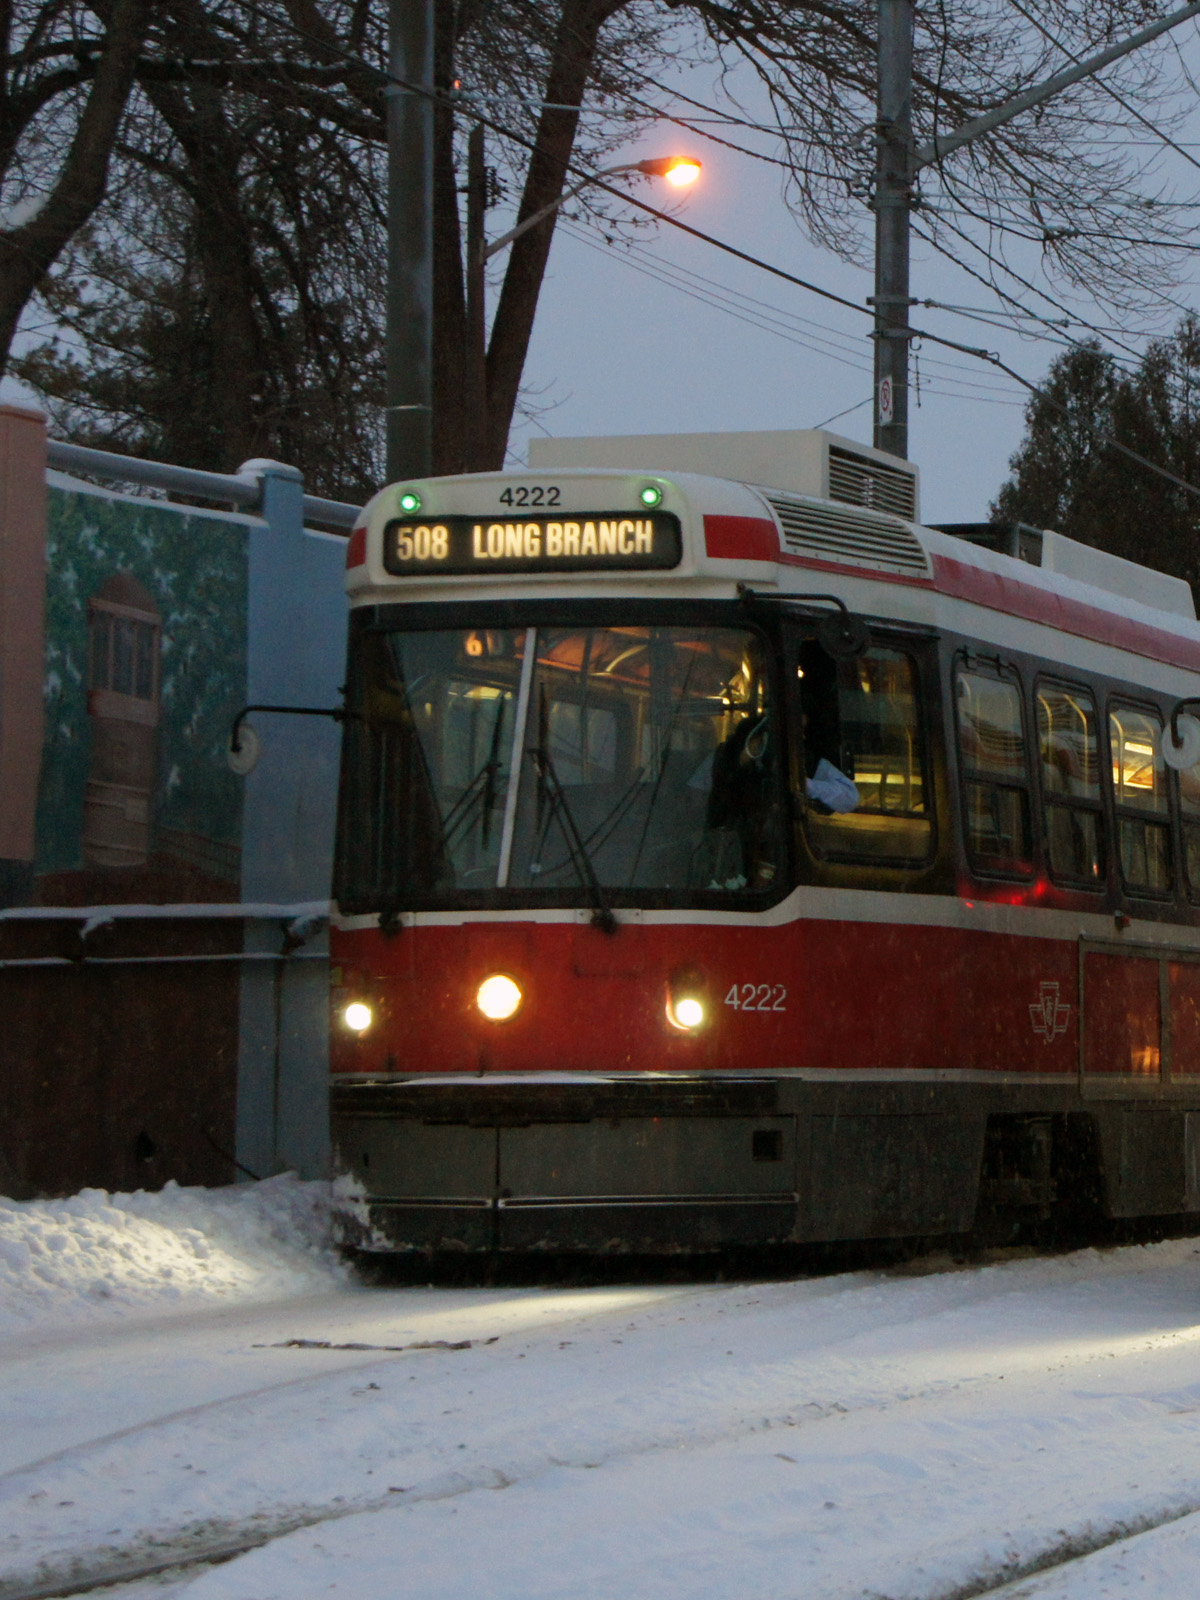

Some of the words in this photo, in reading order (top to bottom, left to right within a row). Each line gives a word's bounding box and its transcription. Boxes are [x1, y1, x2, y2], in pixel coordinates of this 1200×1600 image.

[499, 487, 561, 507] 4222
[397, 525, 448, 560] 508
[472, 523, 540, 559] LONG
[546, 520, 653, 556] BRANCH
[724, 983, 787, 1011] 4222
